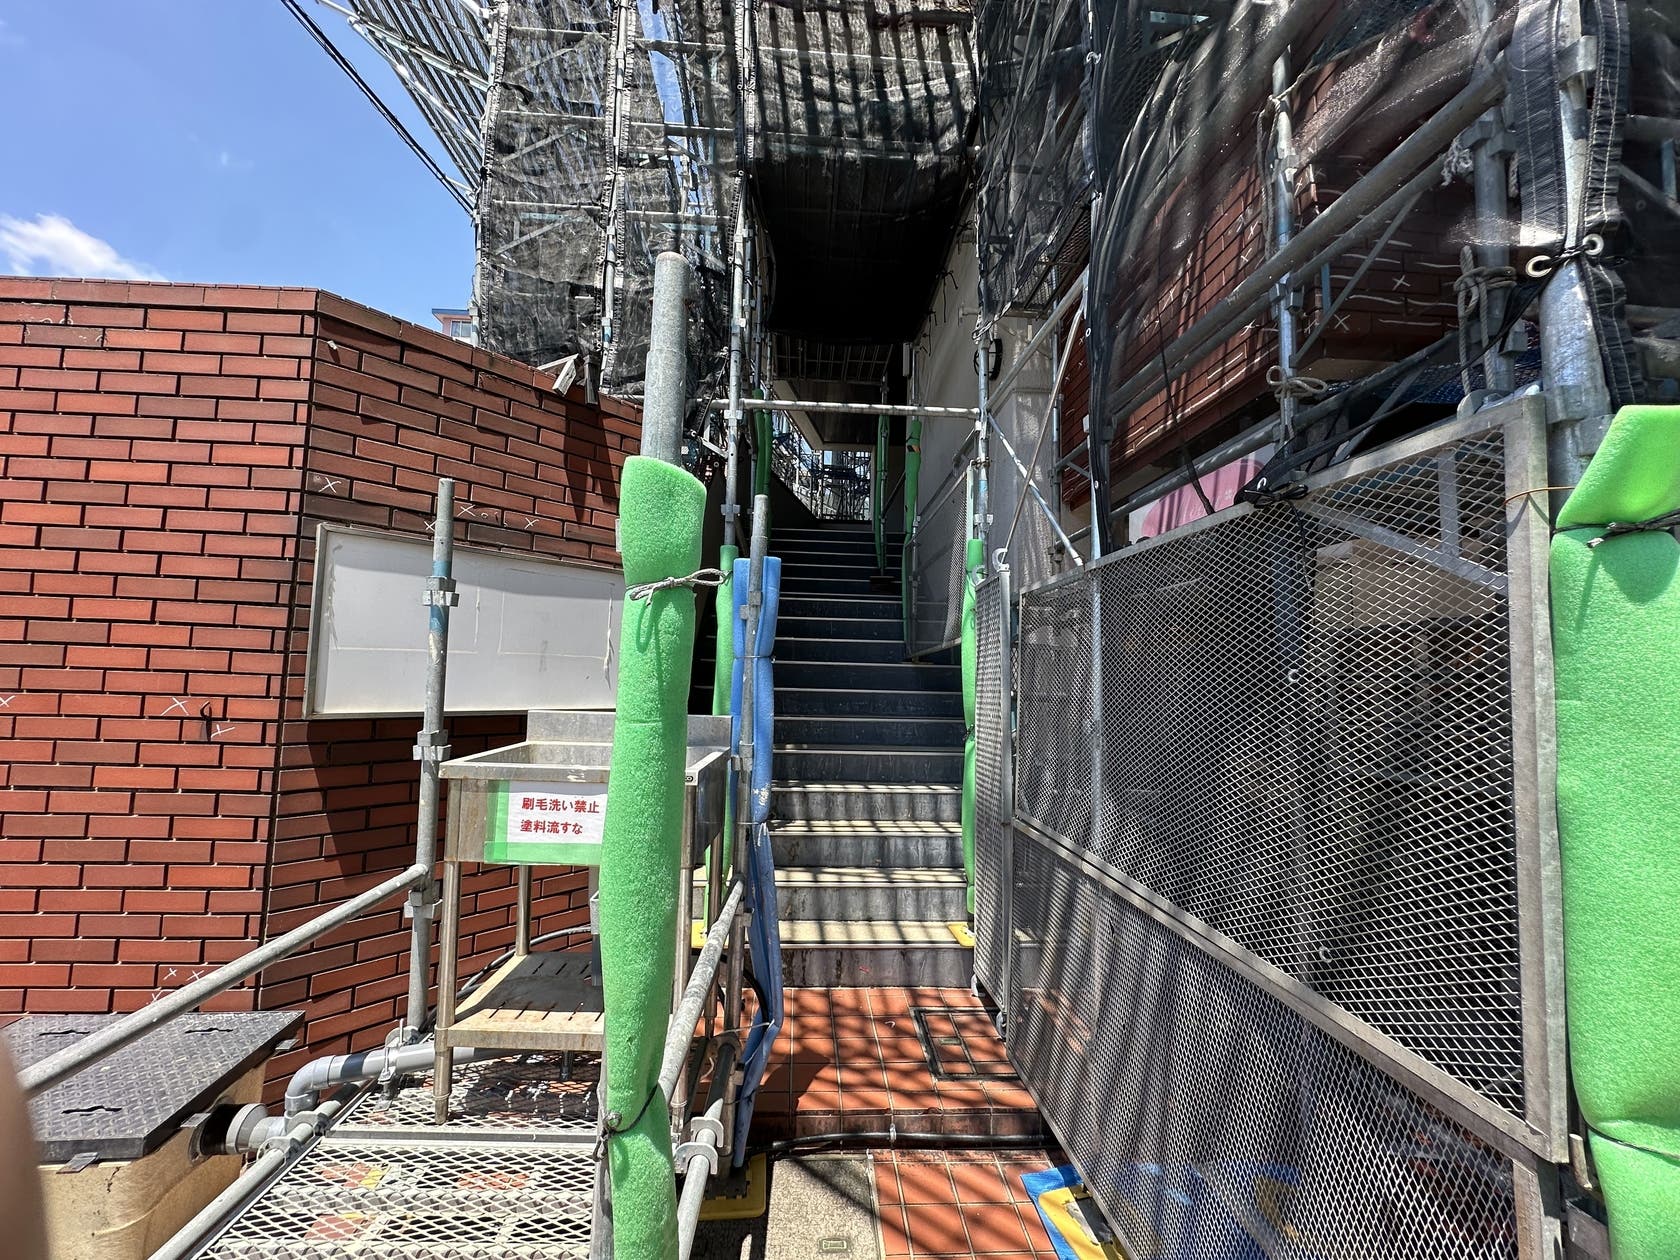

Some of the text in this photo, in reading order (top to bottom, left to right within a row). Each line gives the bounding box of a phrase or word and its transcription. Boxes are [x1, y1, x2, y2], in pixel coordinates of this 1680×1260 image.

[521, 797, 600, 814] 刷毛洗い禁止
[520, 819, 583, 835] 塗料流すな
